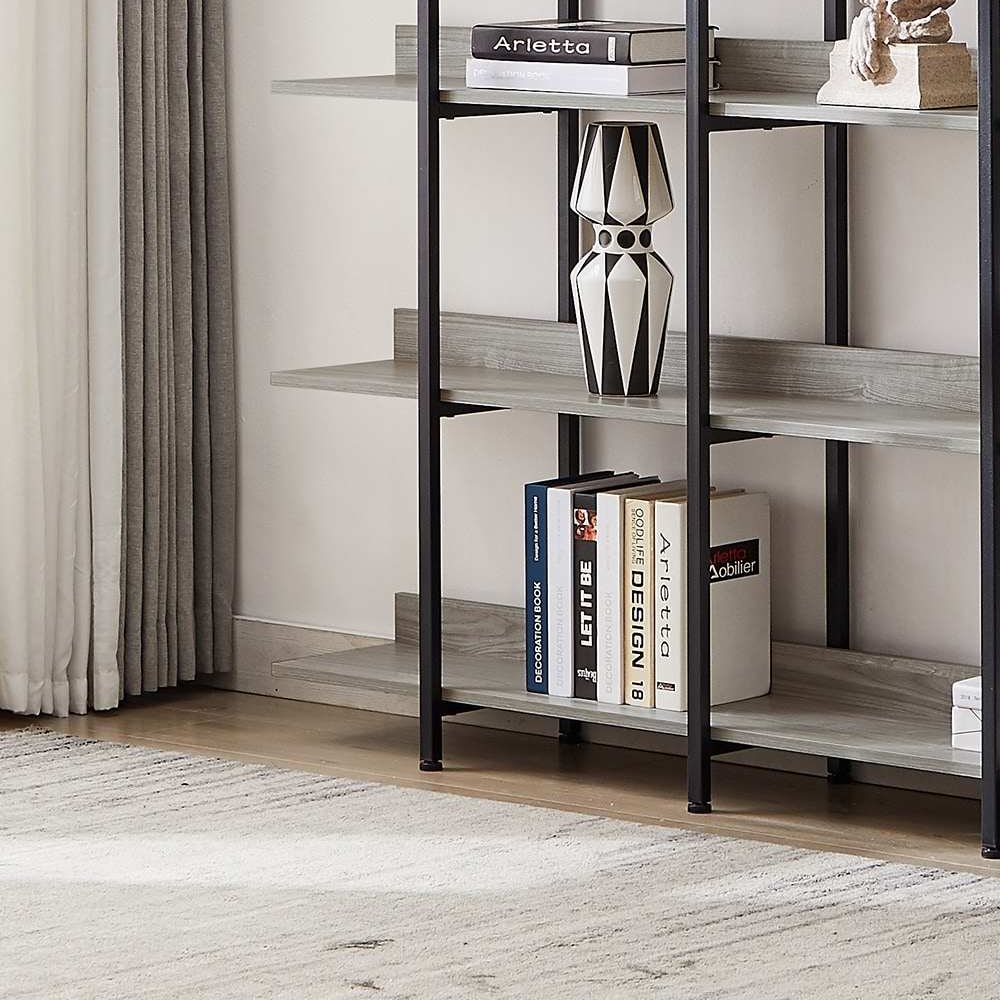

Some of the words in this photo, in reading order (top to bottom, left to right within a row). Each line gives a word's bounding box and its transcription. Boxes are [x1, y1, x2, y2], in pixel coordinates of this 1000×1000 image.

[493, 36, 590, 55] Arletta
[709, 548, 747, 565] rletta
[580, 560, 592, 586] BE
[533, 581, 542, 613] BOOK
[556, 585, 564, 617] BOOK
[580, 589, 593, 608] IT
[604, 591, 612, 623] BOOK
[659, 532, 671, 658] Arletta
[580, 611, 593, 647] LET
[631, 570, 645, 669] DESIGN
[534, 615, 543, 683] DECORATION
[556, 619, 564, 687] DECORATION
[605, 625, 613, 693] DECORATION
[631, 681, 644, 700] 18
